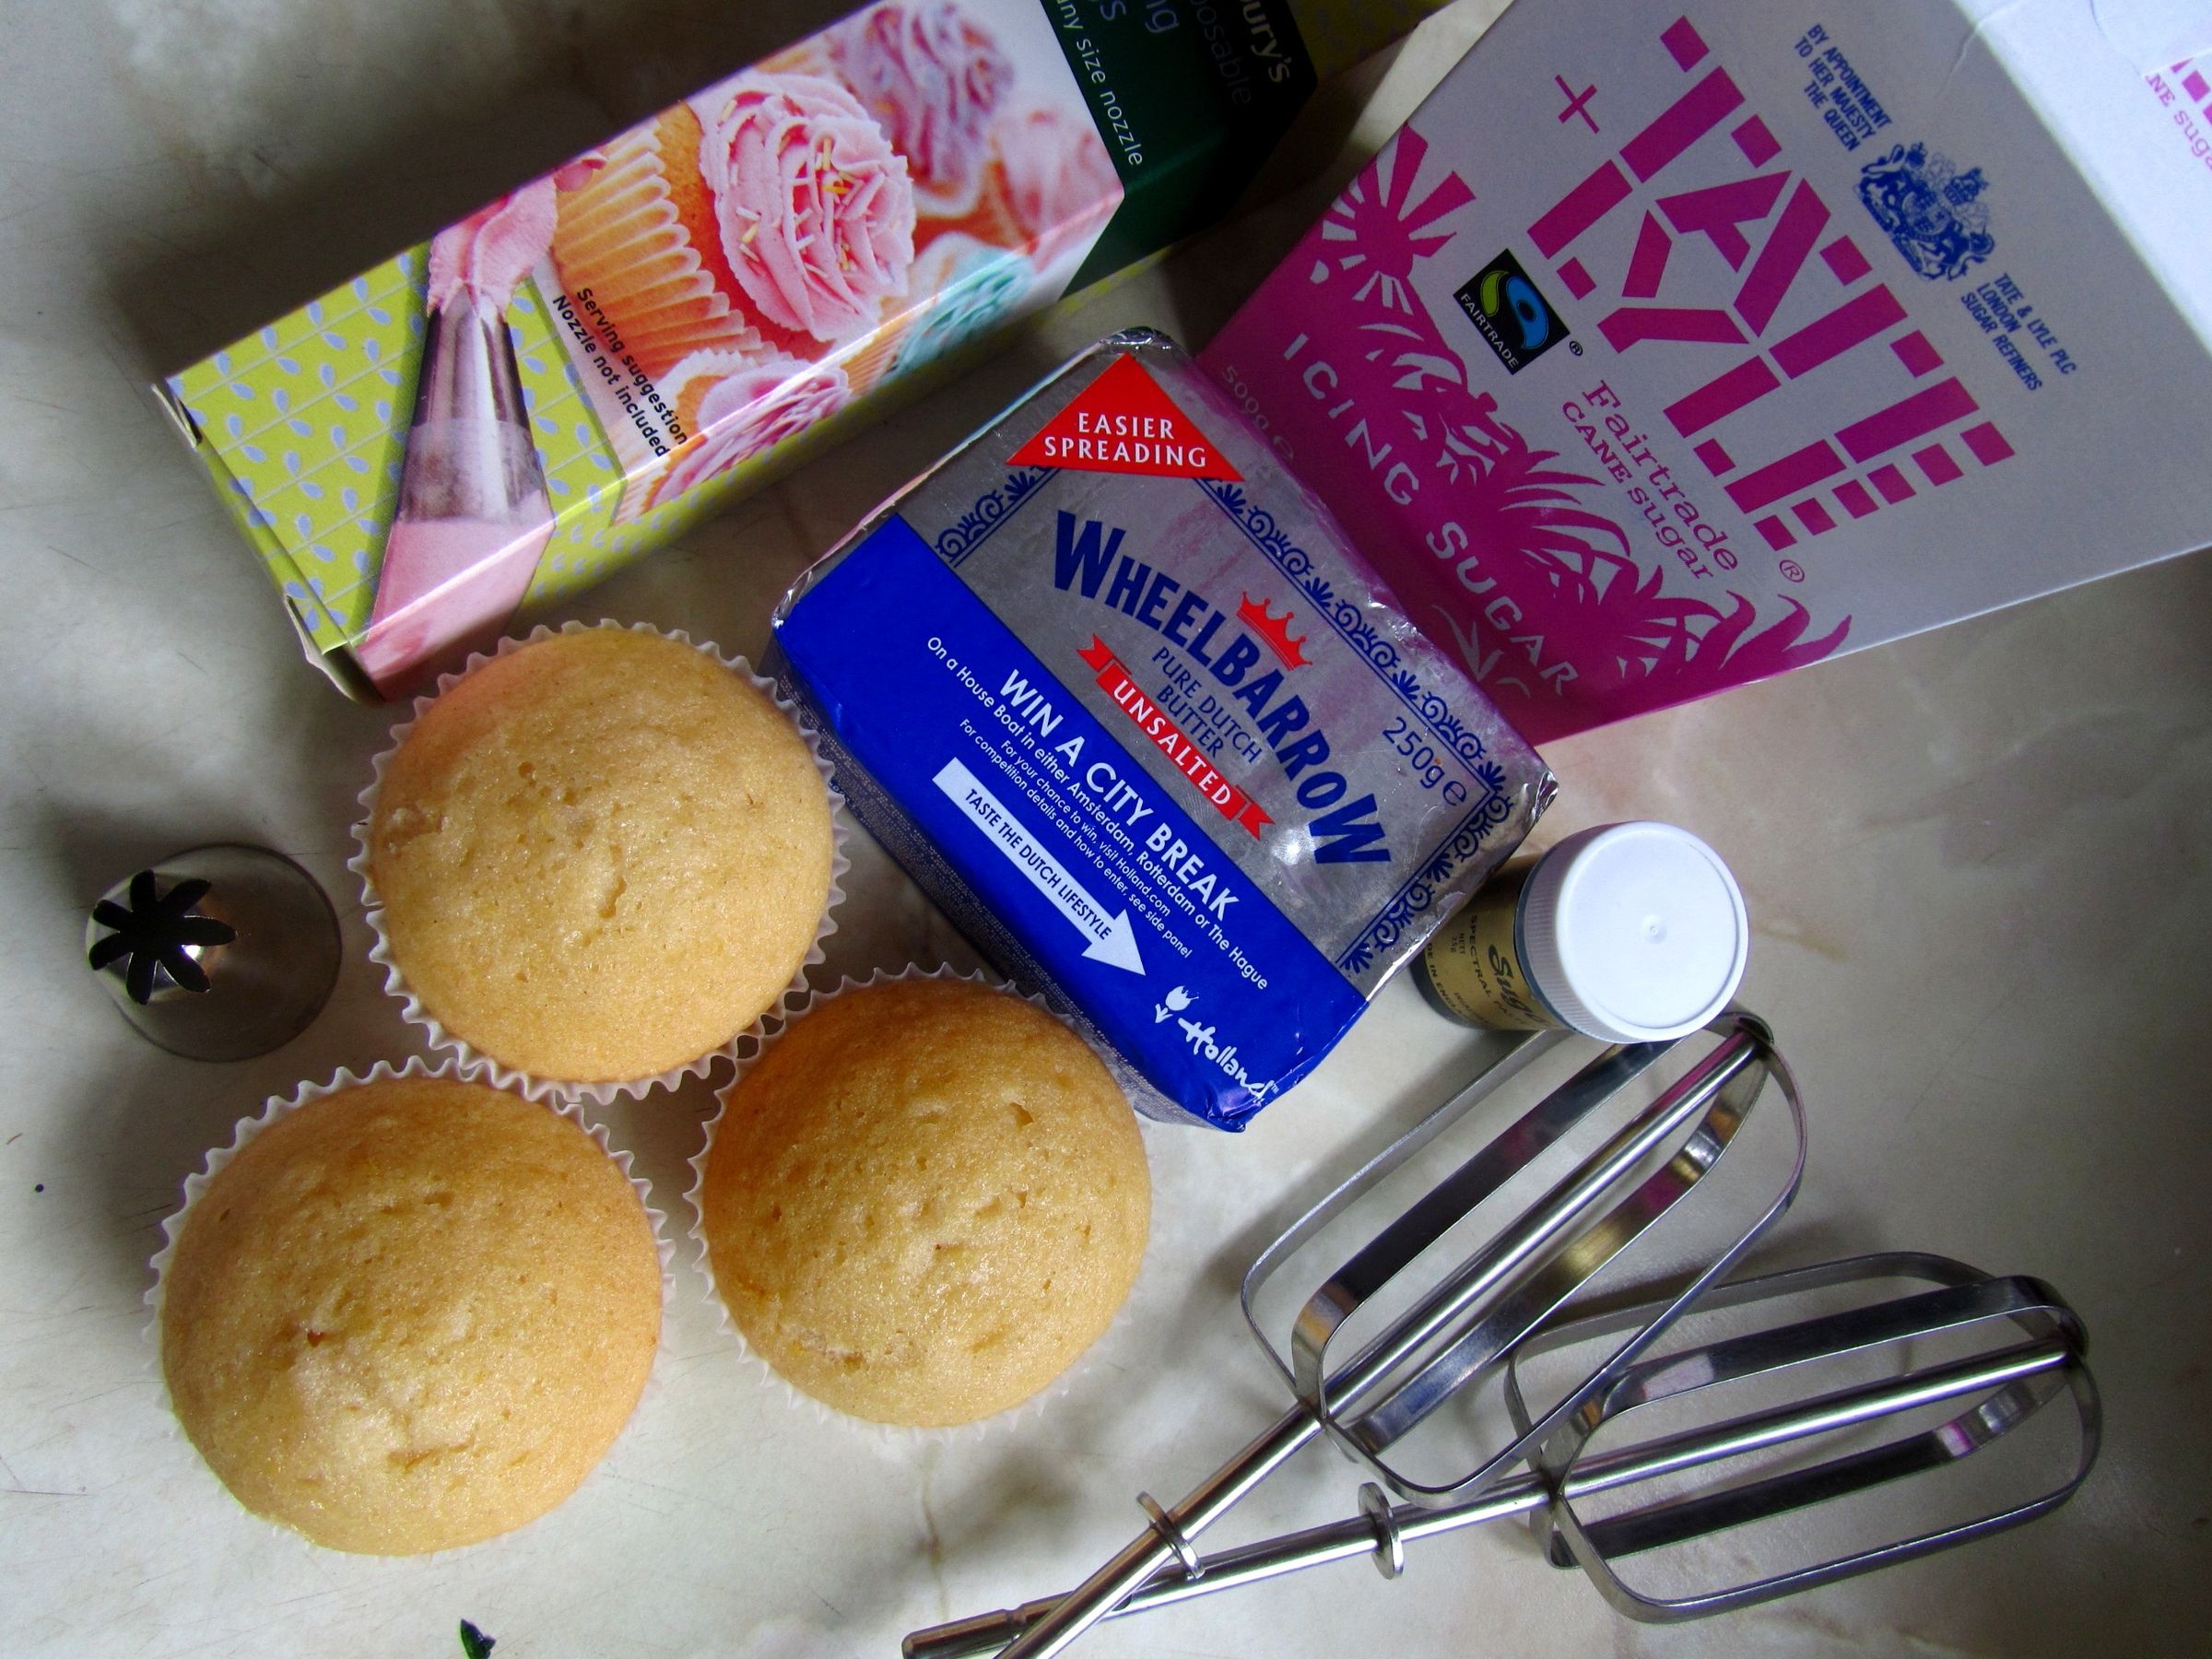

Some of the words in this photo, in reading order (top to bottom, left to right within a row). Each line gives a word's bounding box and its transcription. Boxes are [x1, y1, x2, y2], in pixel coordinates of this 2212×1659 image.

[1239, 0, 1290, 84] ury's
[1794, 36, 1813, 58] TO
[1808, 57, 1834, 87] HER
[1830, 87, 1877, 139] MAJESTY
[1807, 24, 1830, 44] BY
[1823, 47, 1892, 128] APPOINTMENT
[1077, 38, 1106, 84] size
[1100, 90, 1143, 166] nozzle
[1804, 80, 1829, 109] THE
[1824, 109, 1860, 151] QUEEN
[1460, 293, 1519, 369] FAIRTRADE
[1961, 292, 1998, 334] SUGAR
[1993, 335, 2042, 390] REFINERS
[1977, 283, 2021, 333] LONDON
[1994, 273, 2024, 305] TATE
[2017, 305, 2032, 319] &
[2028, 319, 2057, 349] LYLE
[2050, 349, 2077, 374] PLC
[553, 295, 596, 353] Nozzle
[594, 355, 621, 385] not
[615, 385, 670, 457] included
[577, 288, 625, 353] Serving
[622, 355, 688, 444] suggestion
[1044, 437, 1206, 467] SPREADING
[1078, 412, 1174, 440] EASIER
[1582, 380, 1738, 571] Fairtrade
[1283, 333, 1419, 506] ICING
[1426, 521, 1578, 696] SUGAR
[1562, 401, 1632, 484] CANE
[1627, 487, 1714, 580] sugar
[1053, 509, 1391, 865] WHEELBARROW
[1113, 679, 1230, 805] UNSALTED
[1152, 646, 1202, 699] PURE
[1198, 695, 1263, 763] DUTCH
[1157, 684, 1224, 758] BUTTER
[1000, 668, 1064, 737] WIN
[1054, 735, 1085, 767] A
[1086, 762, 1154, 827] CITY
[1145, 822, 1240, 922] BREAK
[1382, 716, 1444, 788] 250g
[927, 637, 947, 660] On
[946, 658, 959, 671] a
[956, 665, 994, 708] House
[994, 704, 1026, 737] Boat
[1020, 732, 1035, 750] in
[1034, 747, 1070, 784] either
[1066, 782, 1135, 856] Amsterdam,
[1135, 850, 1195, 916] Rotterdam
[1194, 913, 1210, 930] or
[1207, 924, 1230, 950] The
[1228, 946, 1268, 990] Hague
[959, 718, 977, 736] For
[974, 735, 1028, 790] competition
[1027, 788, 1057, 820] details
[1055, 818, 1077, 840] and
[1074, 835, 1095, 859] how
[1093, 855, 1104, 869] to
[1103, 867, 1129, 896] enter,
[1128, 893, 1147, 912] see
[1145, 911, 1165, 932] side
[1161, 929, 1193, 959] panel
[965, 788, 1002, 828] TASTE
[997, 821, 1023, 849] THE
[1018, 844, 1062, 888] DUTCH
[1058, 884, 1112, 940] LIFESTYLE
[1000, 740, 1018, 759] For
[1014, 756, 1039, 779] your
[1036, 778, 1071, 814] chance
[1070, 810, 1081, 824] to
[1080, 822, 1098, 844] win,
[1099, 841, 1119, 861] visit
[1115, 857, 1171, 917] Holland.com
[1469, 914, 1492, 996] SPECTRAL
[1177, 1017, 1275, 1101] Holland
